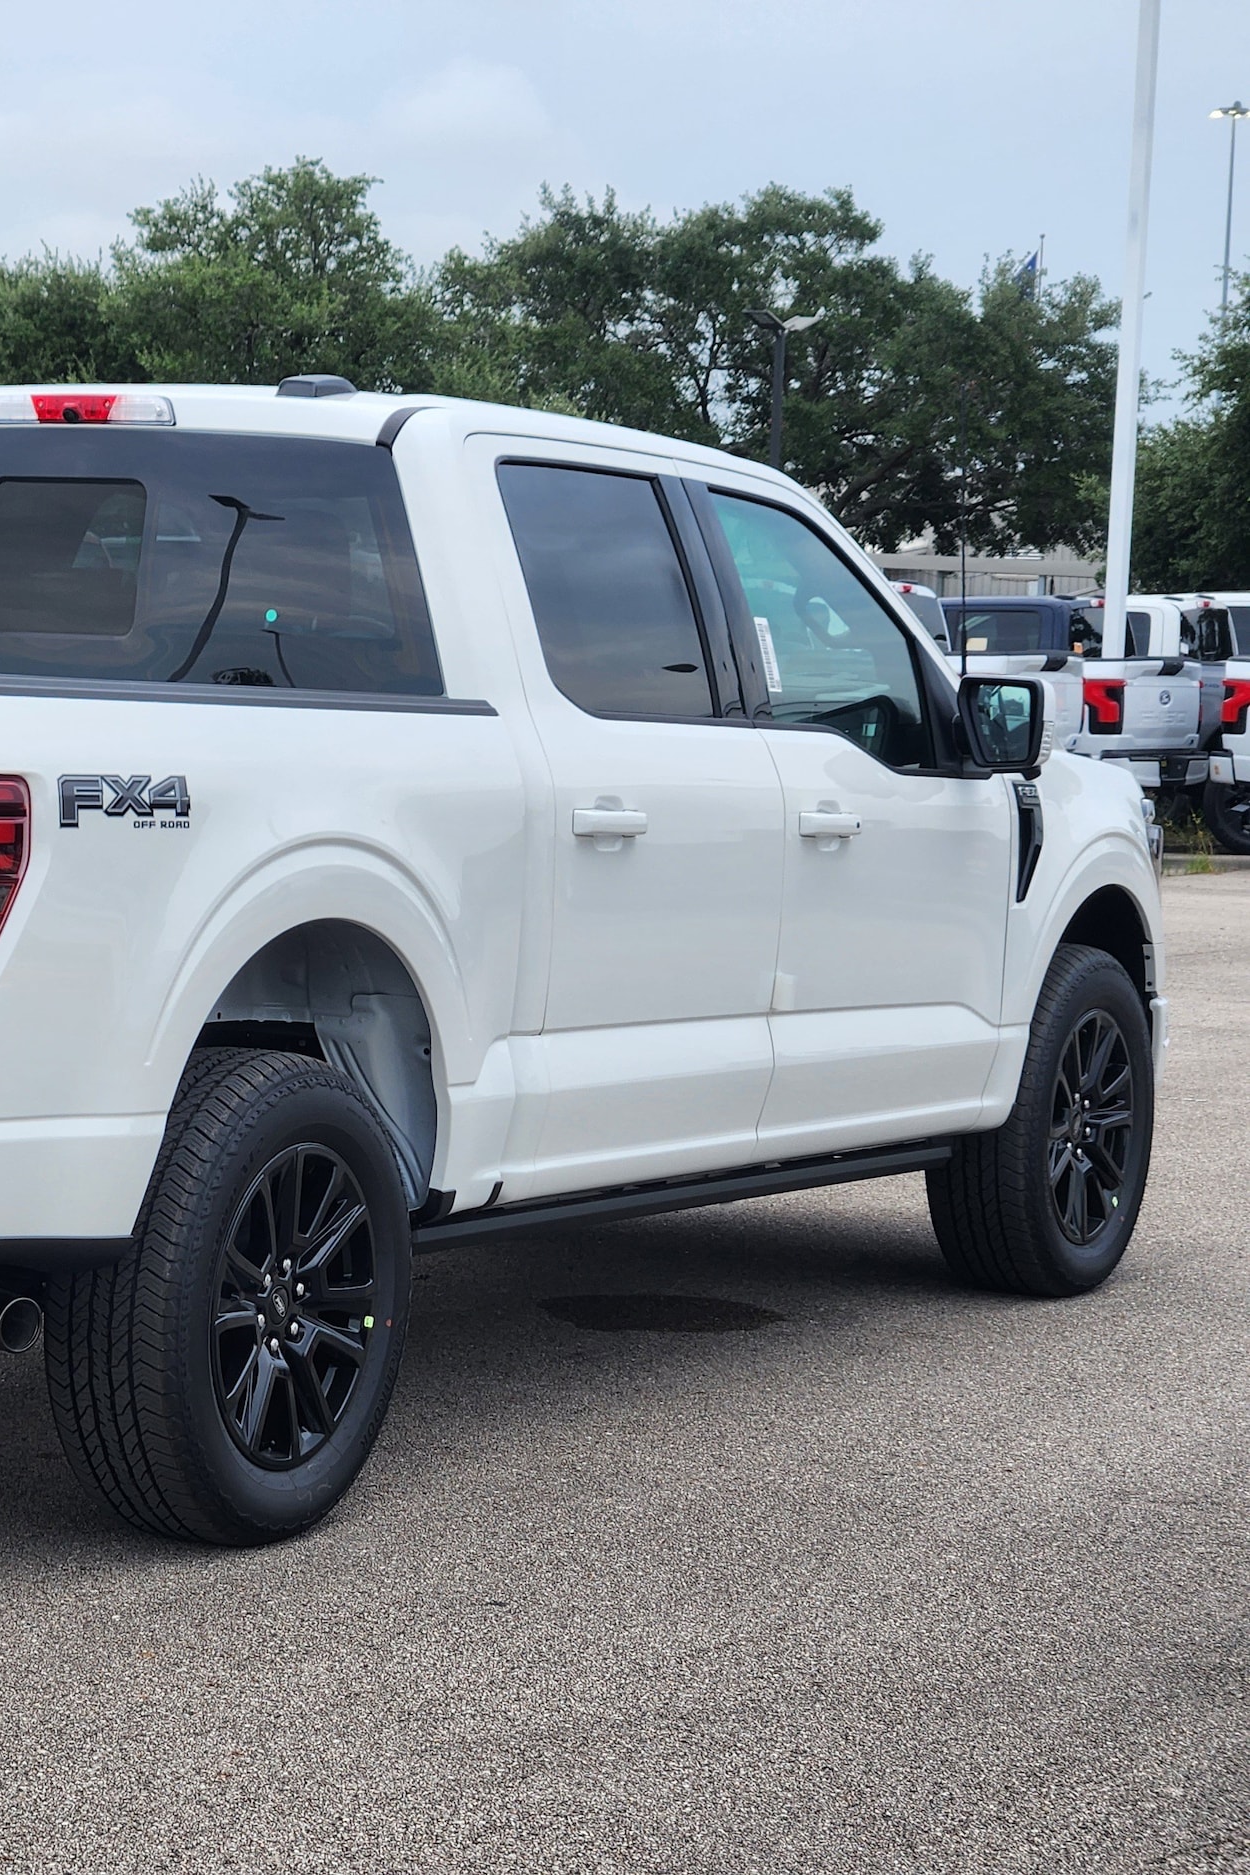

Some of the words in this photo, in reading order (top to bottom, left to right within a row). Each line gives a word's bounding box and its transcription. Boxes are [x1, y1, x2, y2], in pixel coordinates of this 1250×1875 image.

[57, 774, 191, 829] FX4
[133, 820, 156, 829] OFF
[160, 820, 190, 829] ROAD
